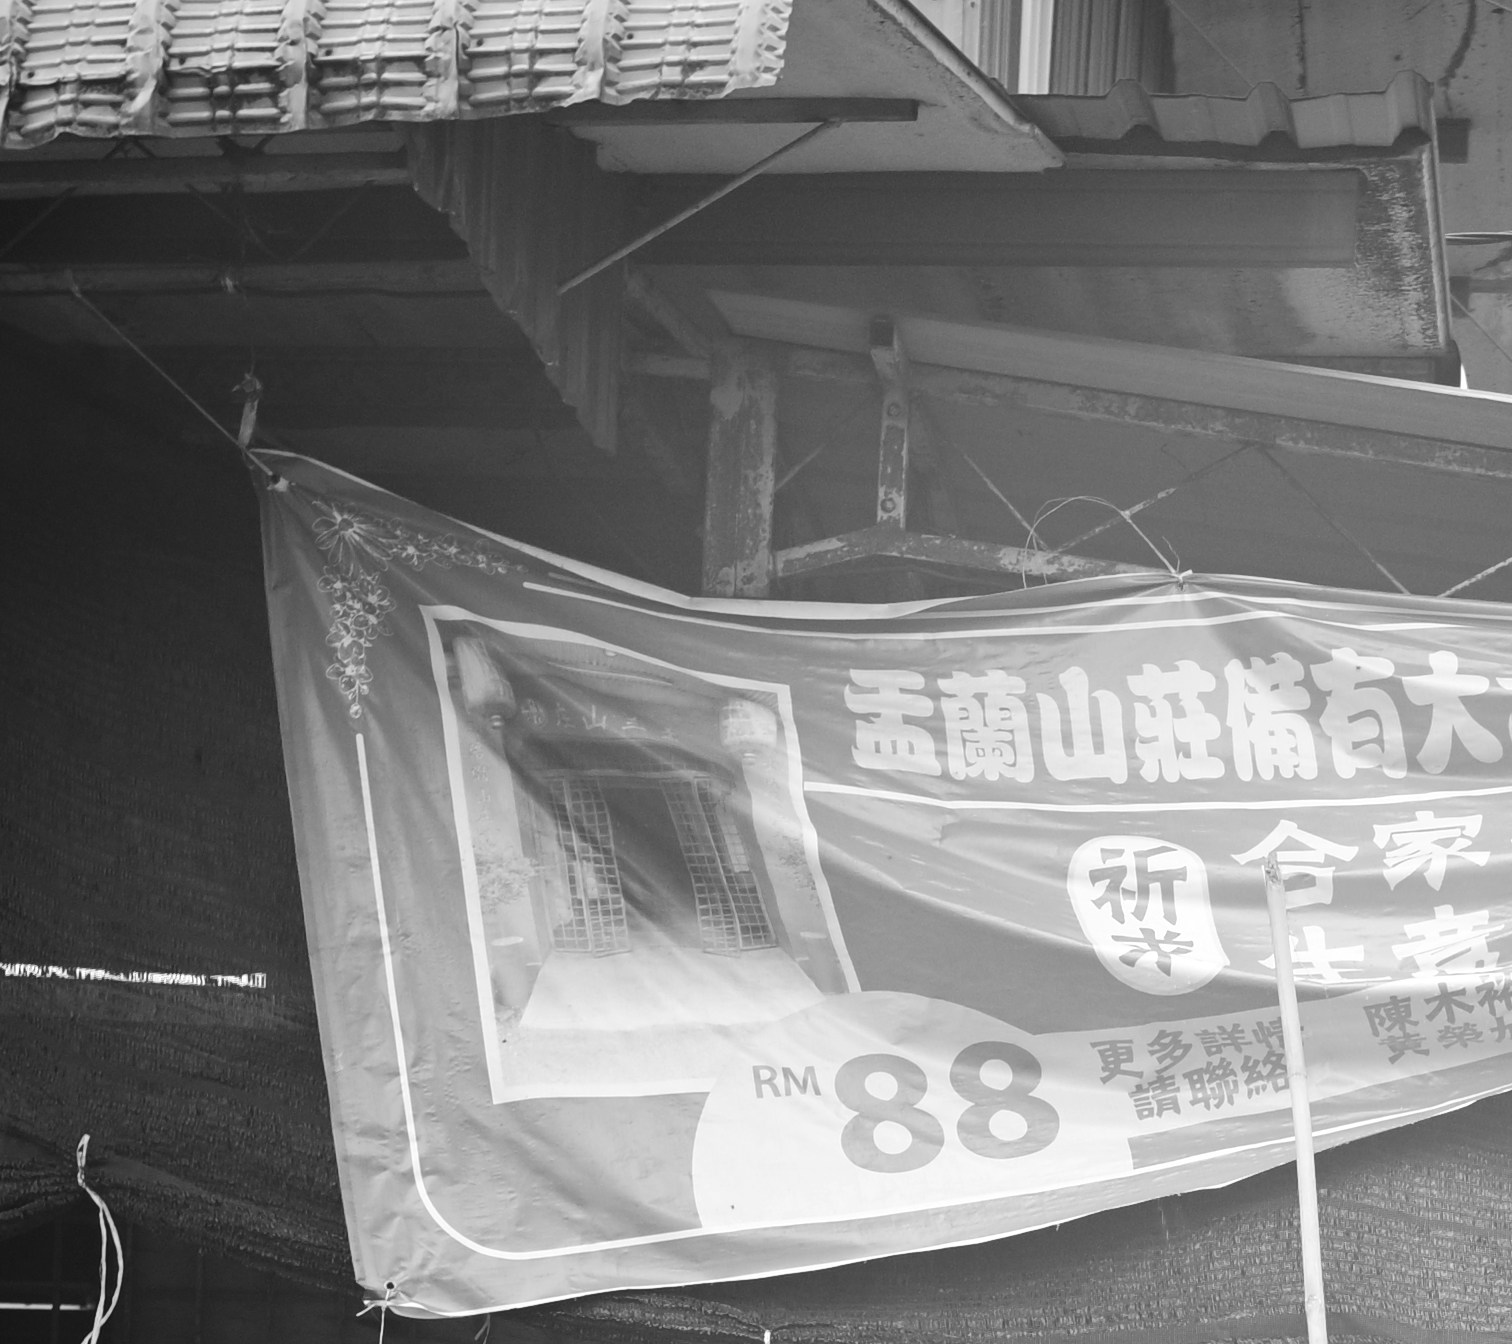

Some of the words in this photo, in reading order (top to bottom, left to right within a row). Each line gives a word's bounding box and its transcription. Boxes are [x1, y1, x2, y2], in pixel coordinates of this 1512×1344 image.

[1089, 845, 1195, 977] 祈求
[1091, 1015, 1305, 1084] 更多詳情
[1128, 1052, 1290, 1120] 請聯絡
[752, 1062, 822, 1100] RM
[835, 1041, 1061, 1174] 88
